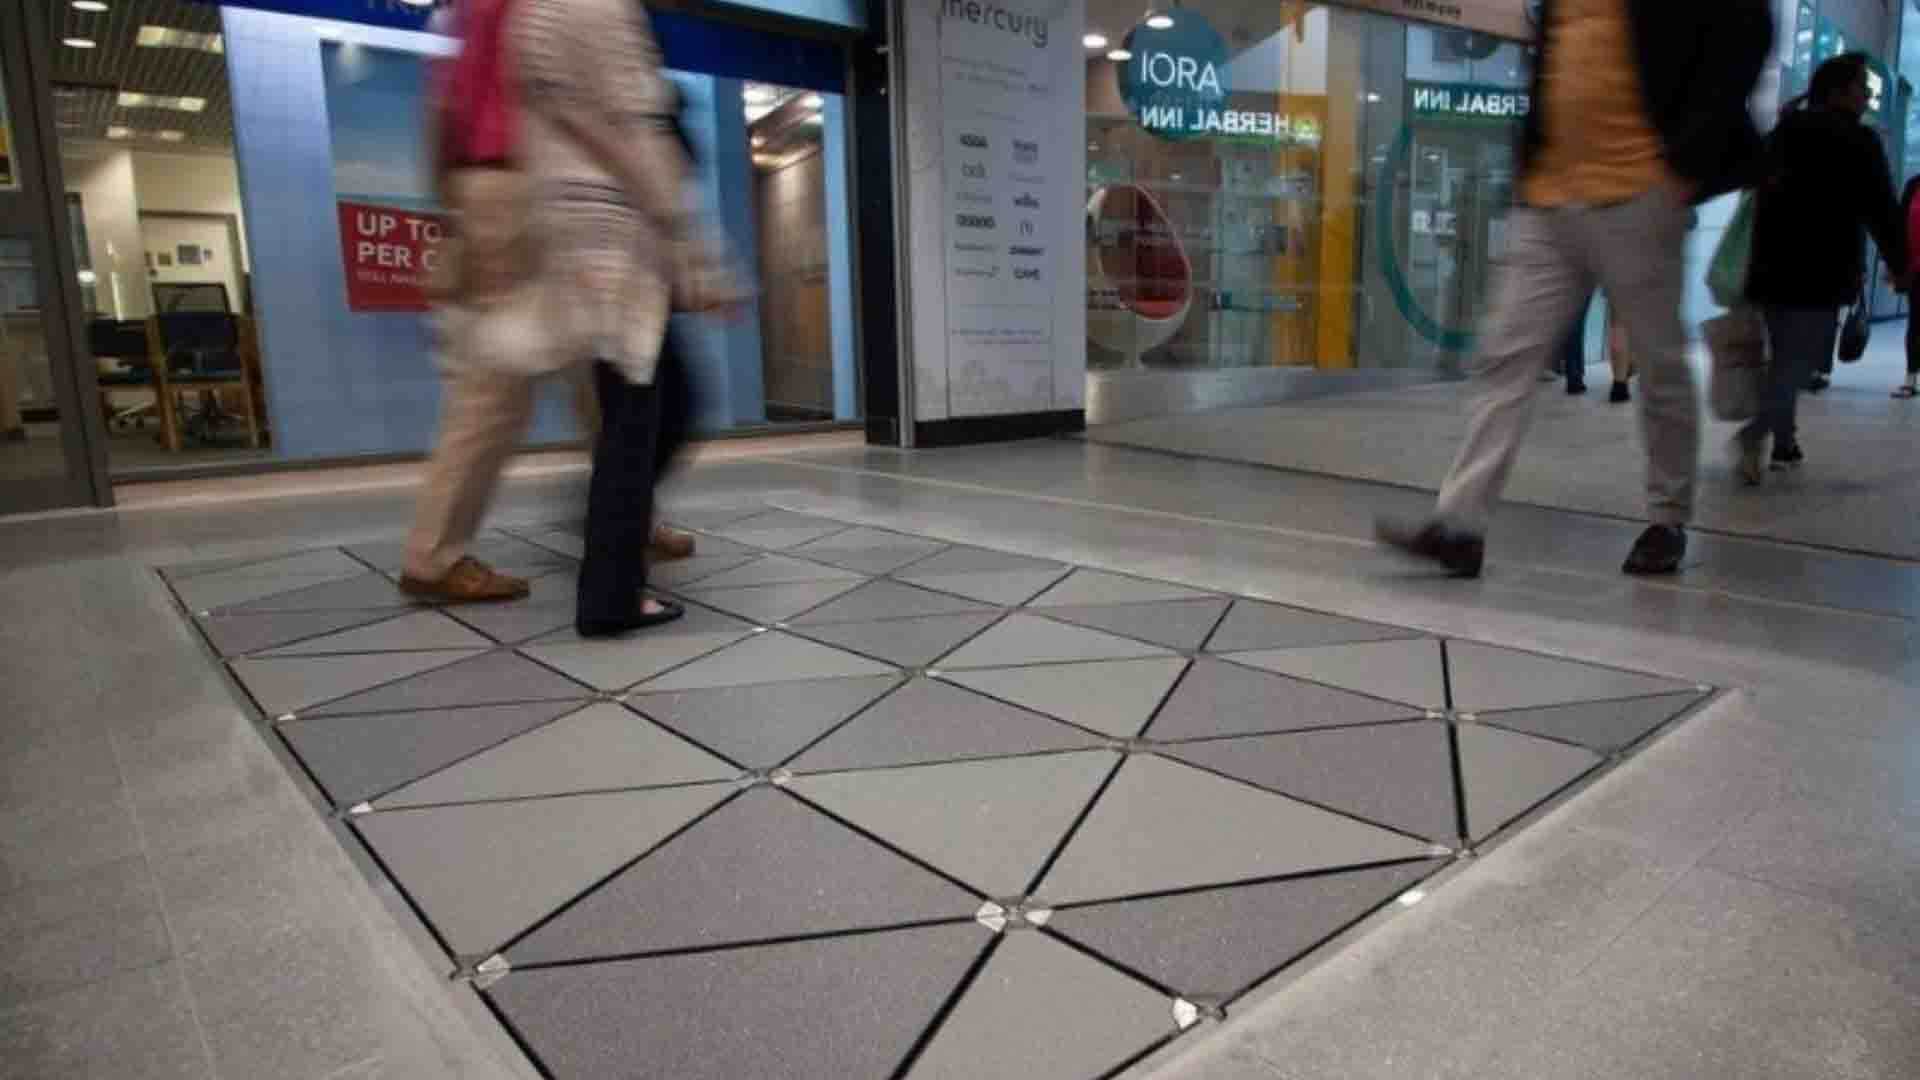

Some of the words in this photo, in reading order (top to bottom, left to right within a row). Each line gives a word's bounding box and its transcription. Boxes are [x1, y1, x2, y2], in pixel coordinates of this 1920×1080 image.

[942, 0, 1049, 49] mercury
[1141, 51, 1222, 96] IORA
[357, 210, 397, 238] UP
[404, 217, 442, 244] TO
[357, 241, 413, 269] PER
[420, 248, 440, 272] C
